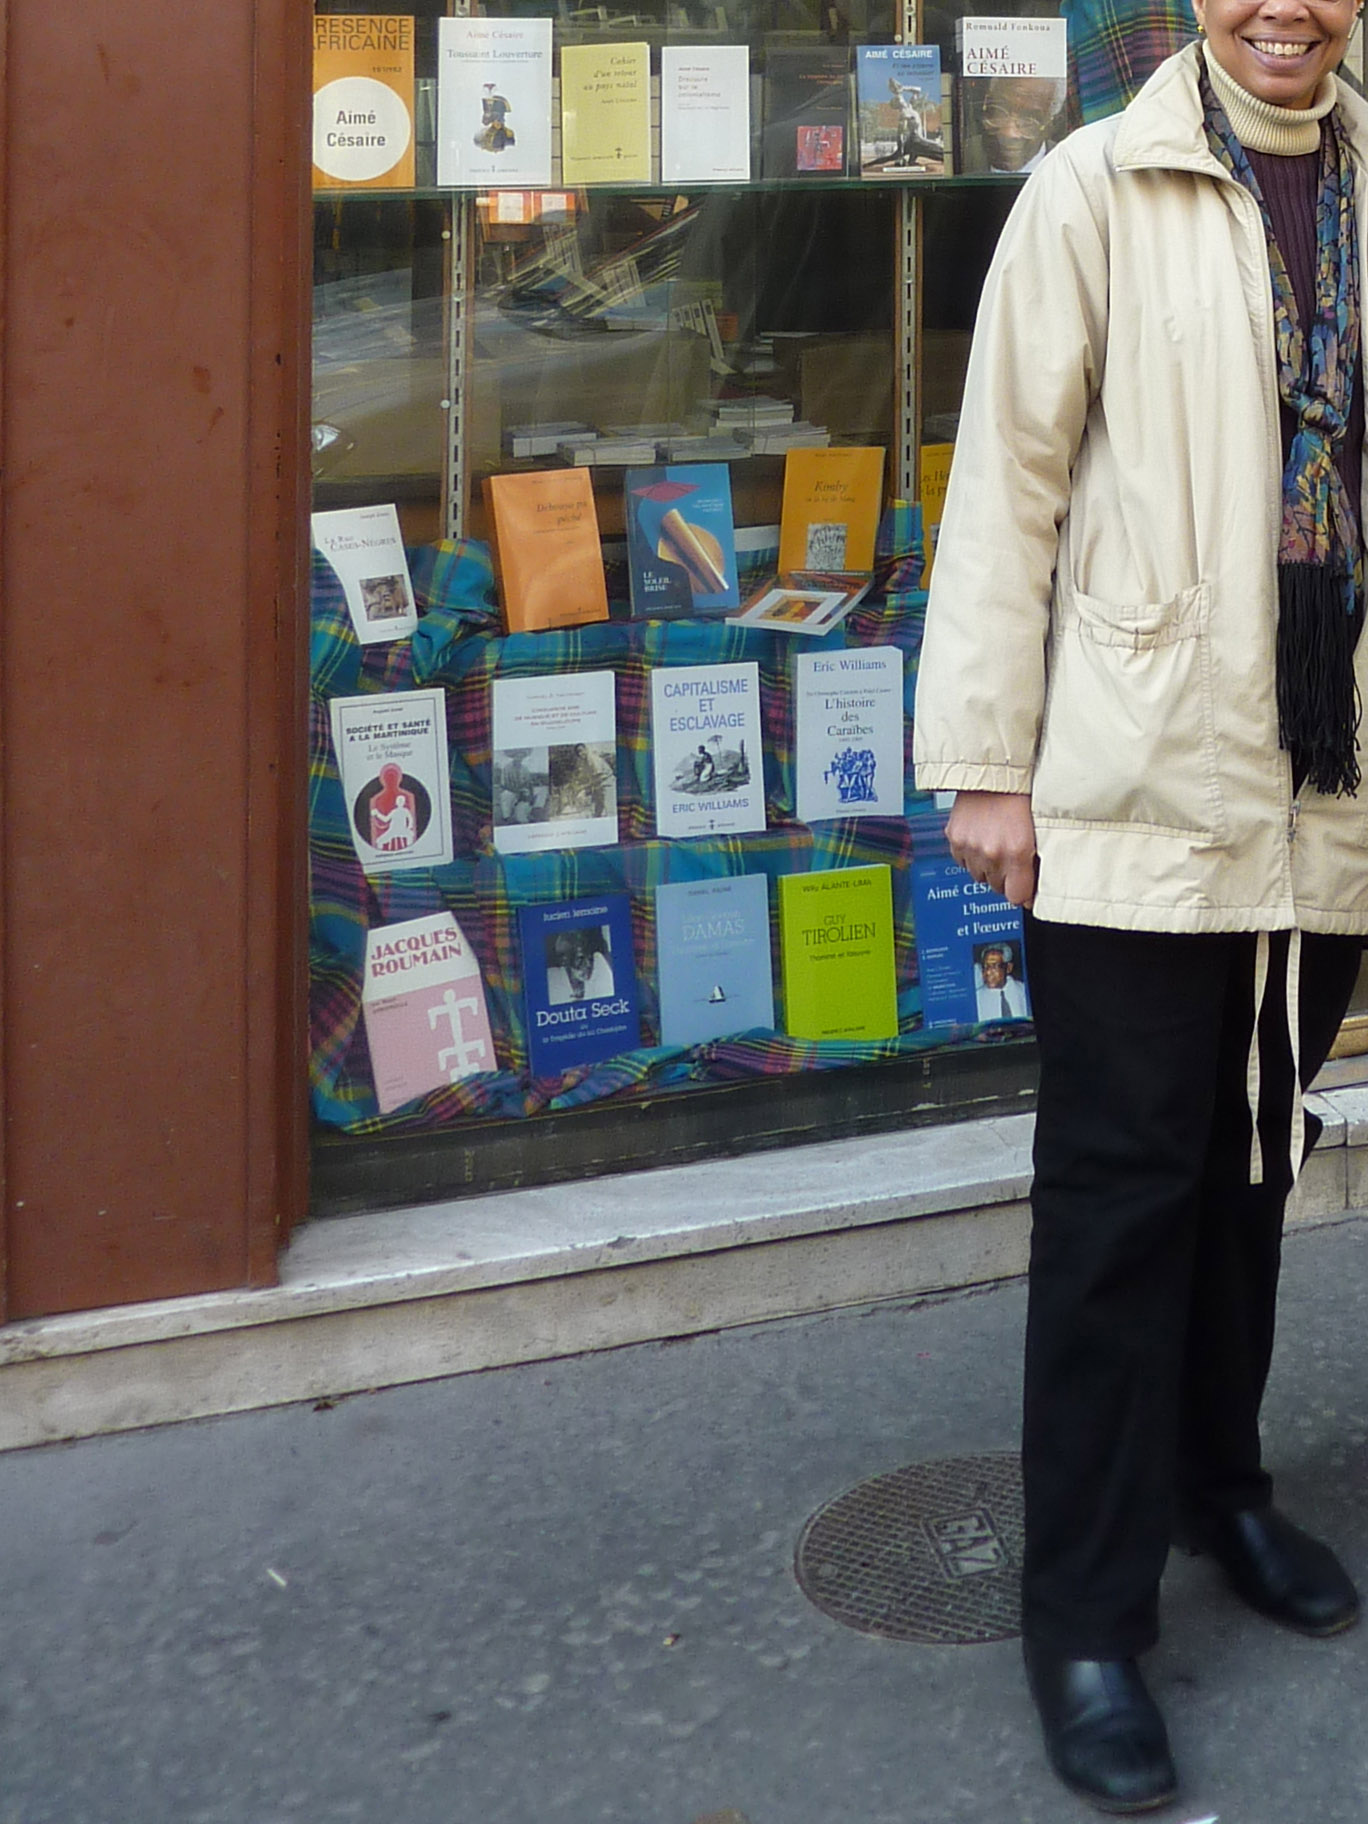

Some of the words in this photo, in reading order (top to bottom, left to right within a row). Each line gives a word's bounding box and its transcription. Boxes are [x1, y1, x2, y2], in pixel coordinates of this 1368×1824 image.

[314, 18, 411, 35] RESENCE
[491, 30, 524, 39] Césaire
[312, 34, 410, 51] FRICAINE
[492, 49, 543, 58] Louverture
[865, 48, 888, 59] AIMÉ
[892, 48, 933, 59] CÉSAIRE
[967, 44, 1010, 60] AIMÉ
[610, 56, 637, 66] Cahier
[967, 61, 1037, 75] CÉSAIRE
[336, 109, 376, 125] Aimé
[326, 132, 386, 147] Césaire
[813, 660, 836, 672] Eric
[839, 659, 887, 671] Williams
[664, 678, 748, 698] CAPITALISME
[699, 698, 715, 712] ET
[825, 696, 876, 710] L'histoire
[669, 712, 745, 732] ESCLAVAGE
[840, 711, 860, 723] des
[345, 723, 386, 736] SOCIÉTÉ
[386, 721, 400, 731] ET
[401, 718, 432, 729] SANTÉ
[357, 733, 370, 742] LA
[373, 726, 429, 740] MARTINIQUE
[826, 723, 874, 737] Caraïbes
[367, 744, 378, 753] Le
[378, 741, 412, 754] Système
[384, 748, 414, 761] Masque
[672, 802, 696, 814] ERIC
[699, 798, 749, 811] WILLIAMS
[927, 884, 960, 901] Aimé
[963, 901, 1019, 916] L'homme
[823, 914, 846, 926] GUY
[957, 925, 970, 937] et
[973, 919, 1020, 936] l'œuvre
[682, 919, 745, 942] DAMAS
[802, 922, 876, 946] TIROLIEN
[370, 926, 458, 962] JACQUES
[371, 942, 462, 978] ROUMAIN
[536, 1007, 588, 1026] Douta
[590, 1000, 631, 1016] Seck
